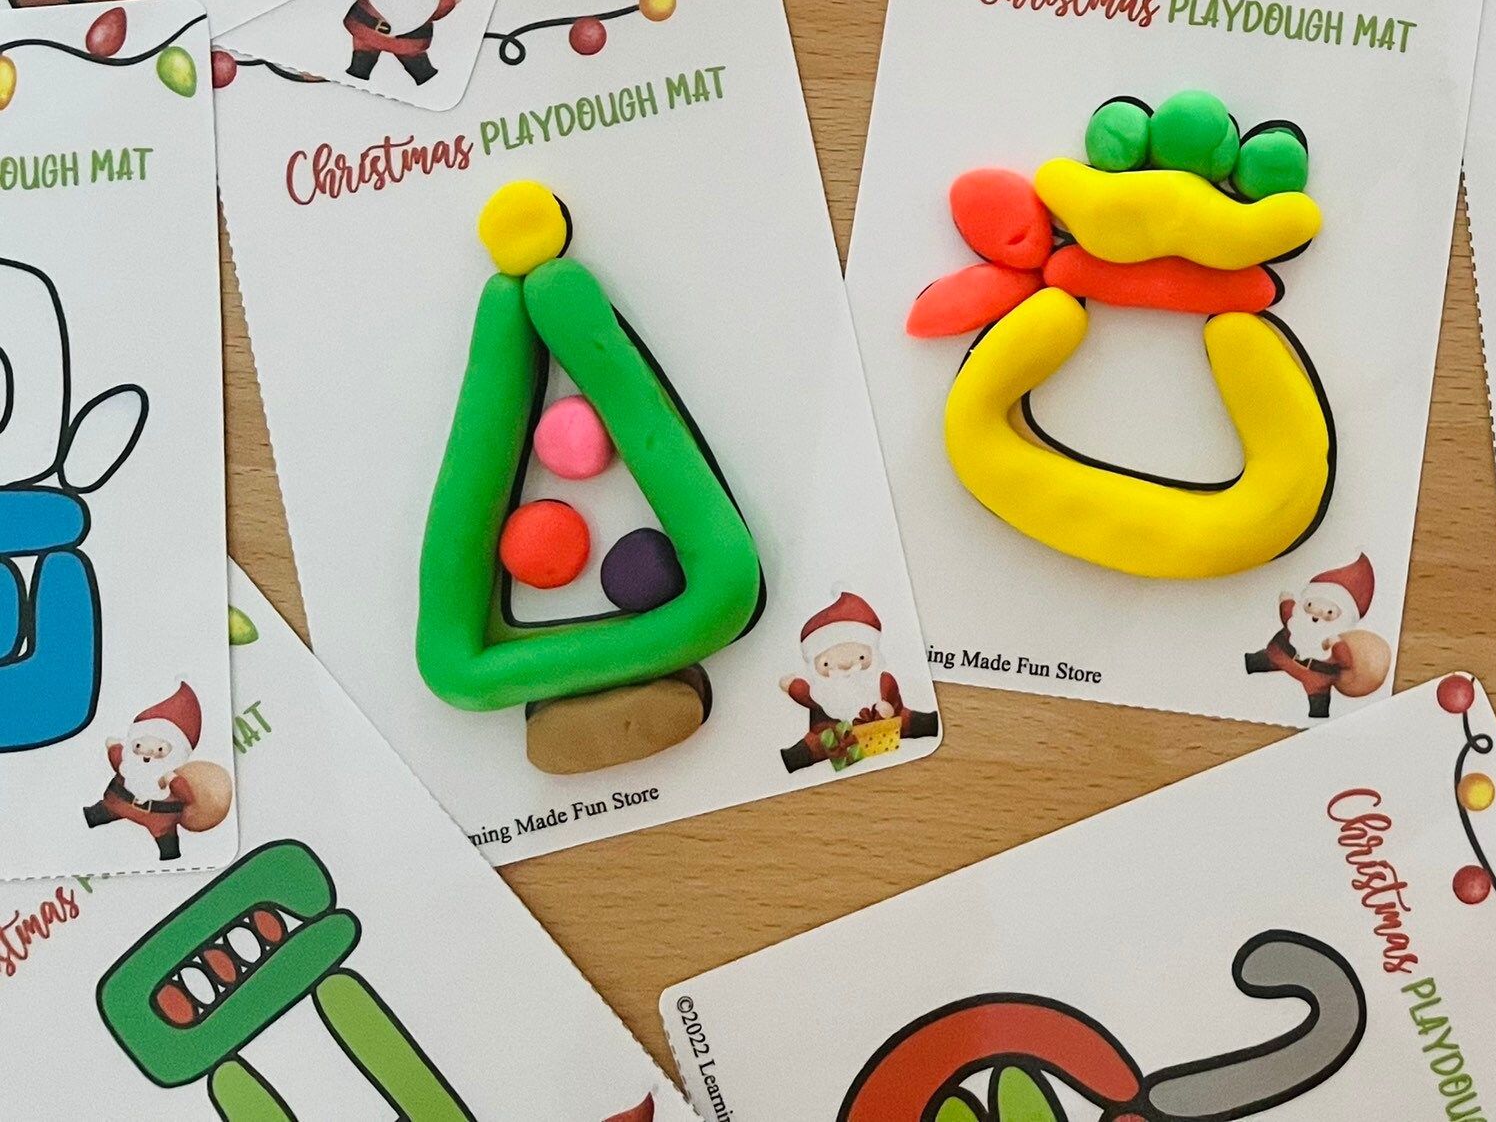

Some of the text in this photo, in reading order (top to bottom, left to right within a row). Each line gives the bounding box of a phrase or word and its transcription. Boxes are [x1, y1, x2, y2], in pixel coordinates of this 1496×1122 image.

[1352, 13, 1419, 54] MAT
[285, 65, 727, 206] Christmas PLAYDOUGH MAT
[90, 147, 154, 183] MAT
[961, 650, 1012, 672] Made
[1016, 657, 1051, 678] Fun
[1055, 662, 1103, 684] Store
[515, 809, 569, 836] Made
[572, 801, 609, 821] Fun
[612, 787, 660, 810] Store
[1327, 787, 1488, 1122] Christmas PLAYDOU
[676, 995, 711, 1059] ©2022
